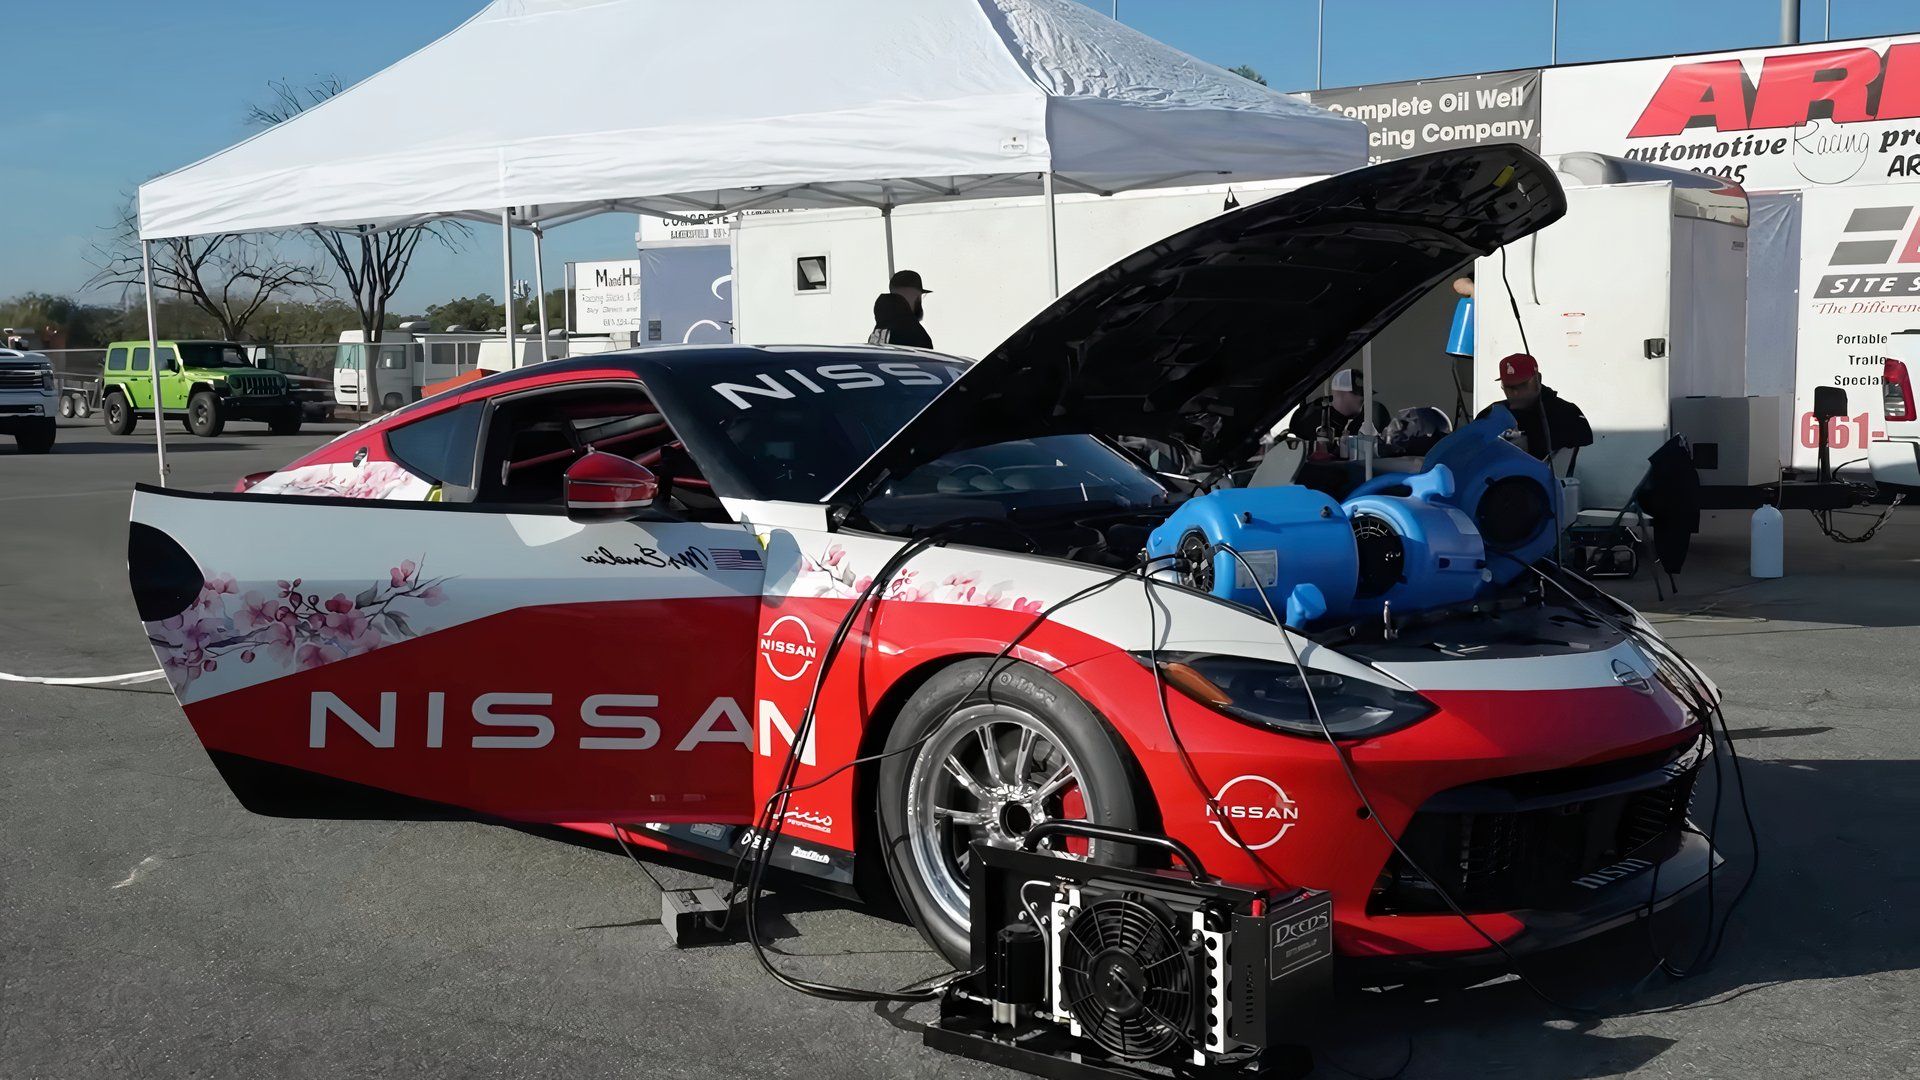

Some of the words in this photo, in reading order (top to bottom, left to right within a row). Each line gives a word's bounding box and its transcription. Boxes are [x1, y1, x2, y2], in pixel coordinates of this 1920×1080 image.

[1439, 92, 1469, 112] Oil
[1476, 87, 1524, 110] Well
[1369, 127, 1415, 149] cing
[1422, 119, 1534, 143] Company
[1625, 134, 1788, 163] automotive
[1830, 277, 1898, 293] SITE
[1836, 334, 1888, 344] Portable
[1848, 355, 1886, 365] Traile
[761, 638, 817, 659] NISSAN
[1206, 804, 1299, 820] NISSAN
